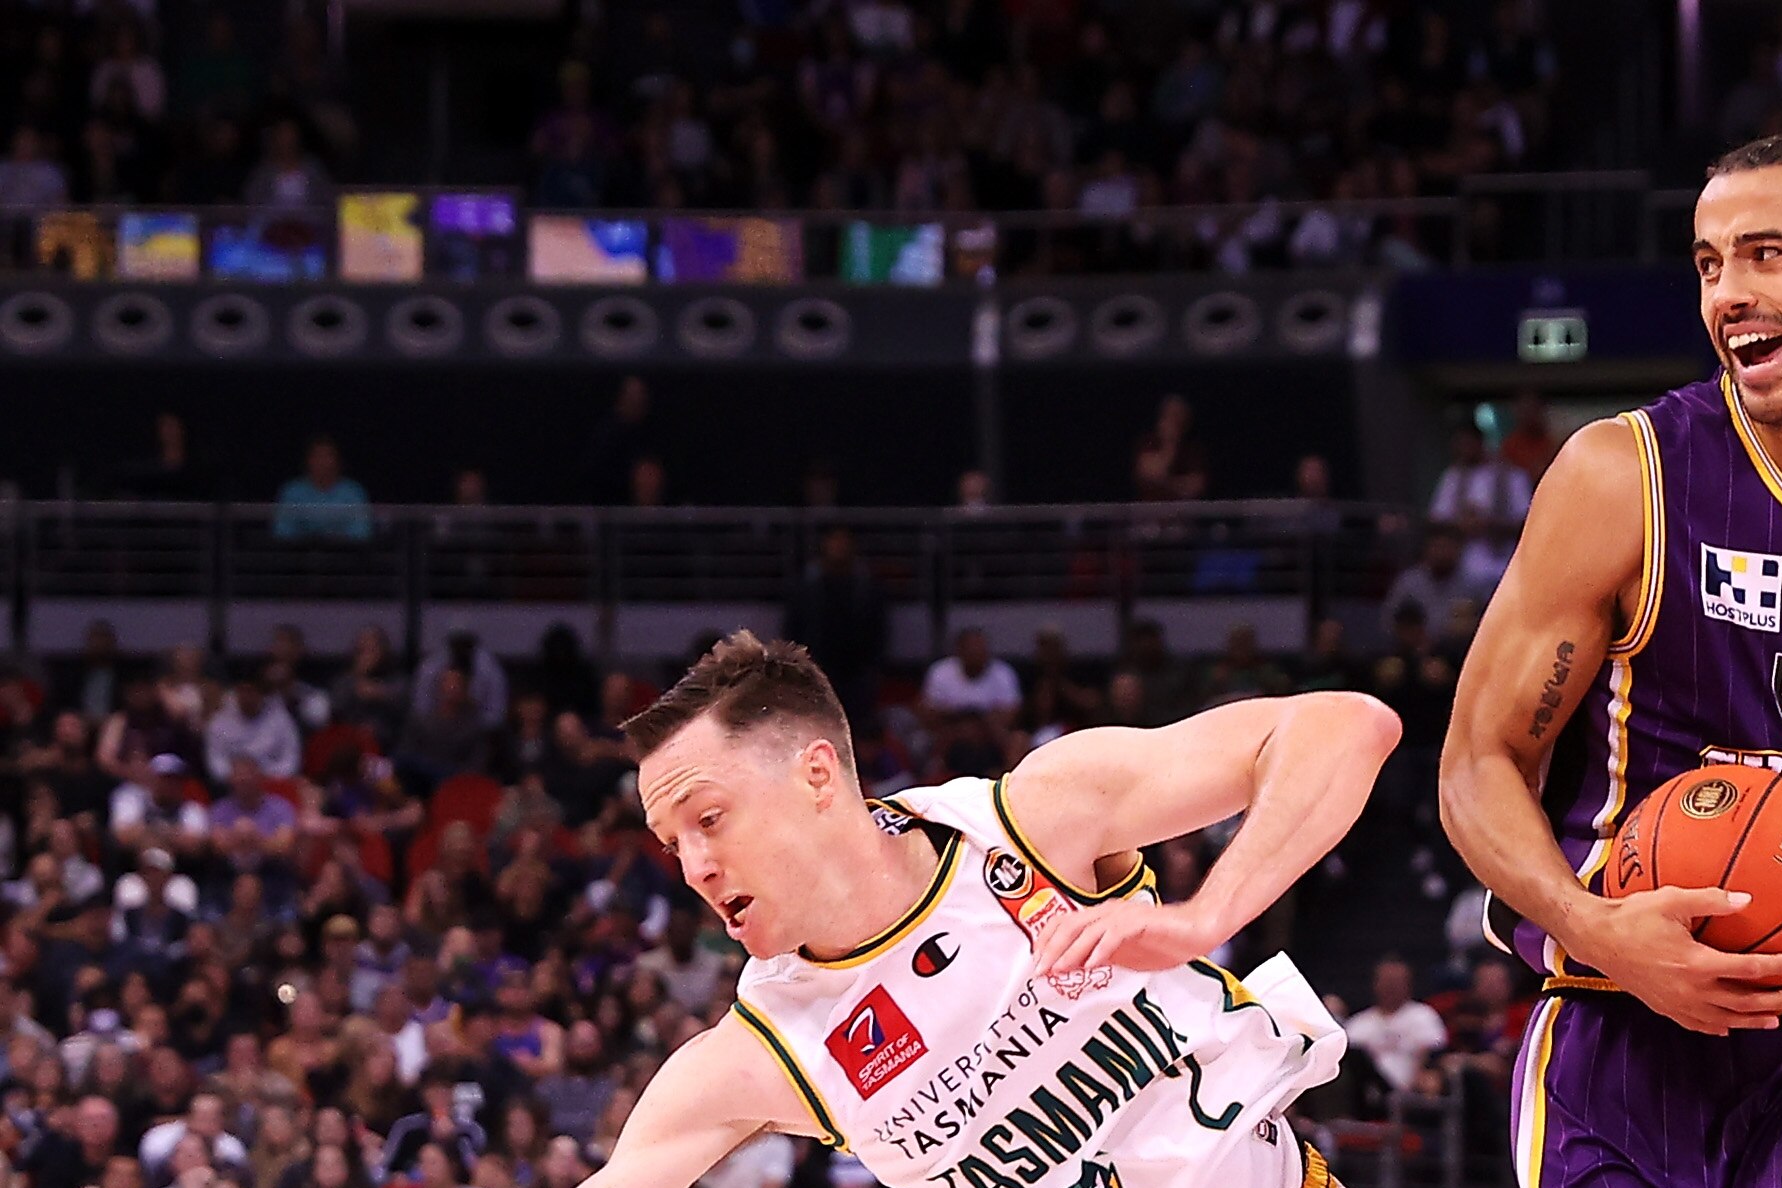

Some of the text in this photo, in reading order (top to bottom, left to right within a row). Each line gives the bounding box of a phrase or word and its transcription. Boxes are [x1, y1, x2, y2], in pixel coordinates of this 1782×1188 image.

[1706, 601, 1777, 628] HOSTPLUS
[858, 1033, 910, 1082] SPIRIT OF
[861, 1040, 922, 1091] TASMANIA
[874, 1006, 1017, 1142] UNIVERSITY
[889, 1007, 1069, 1160] TASMANIA
